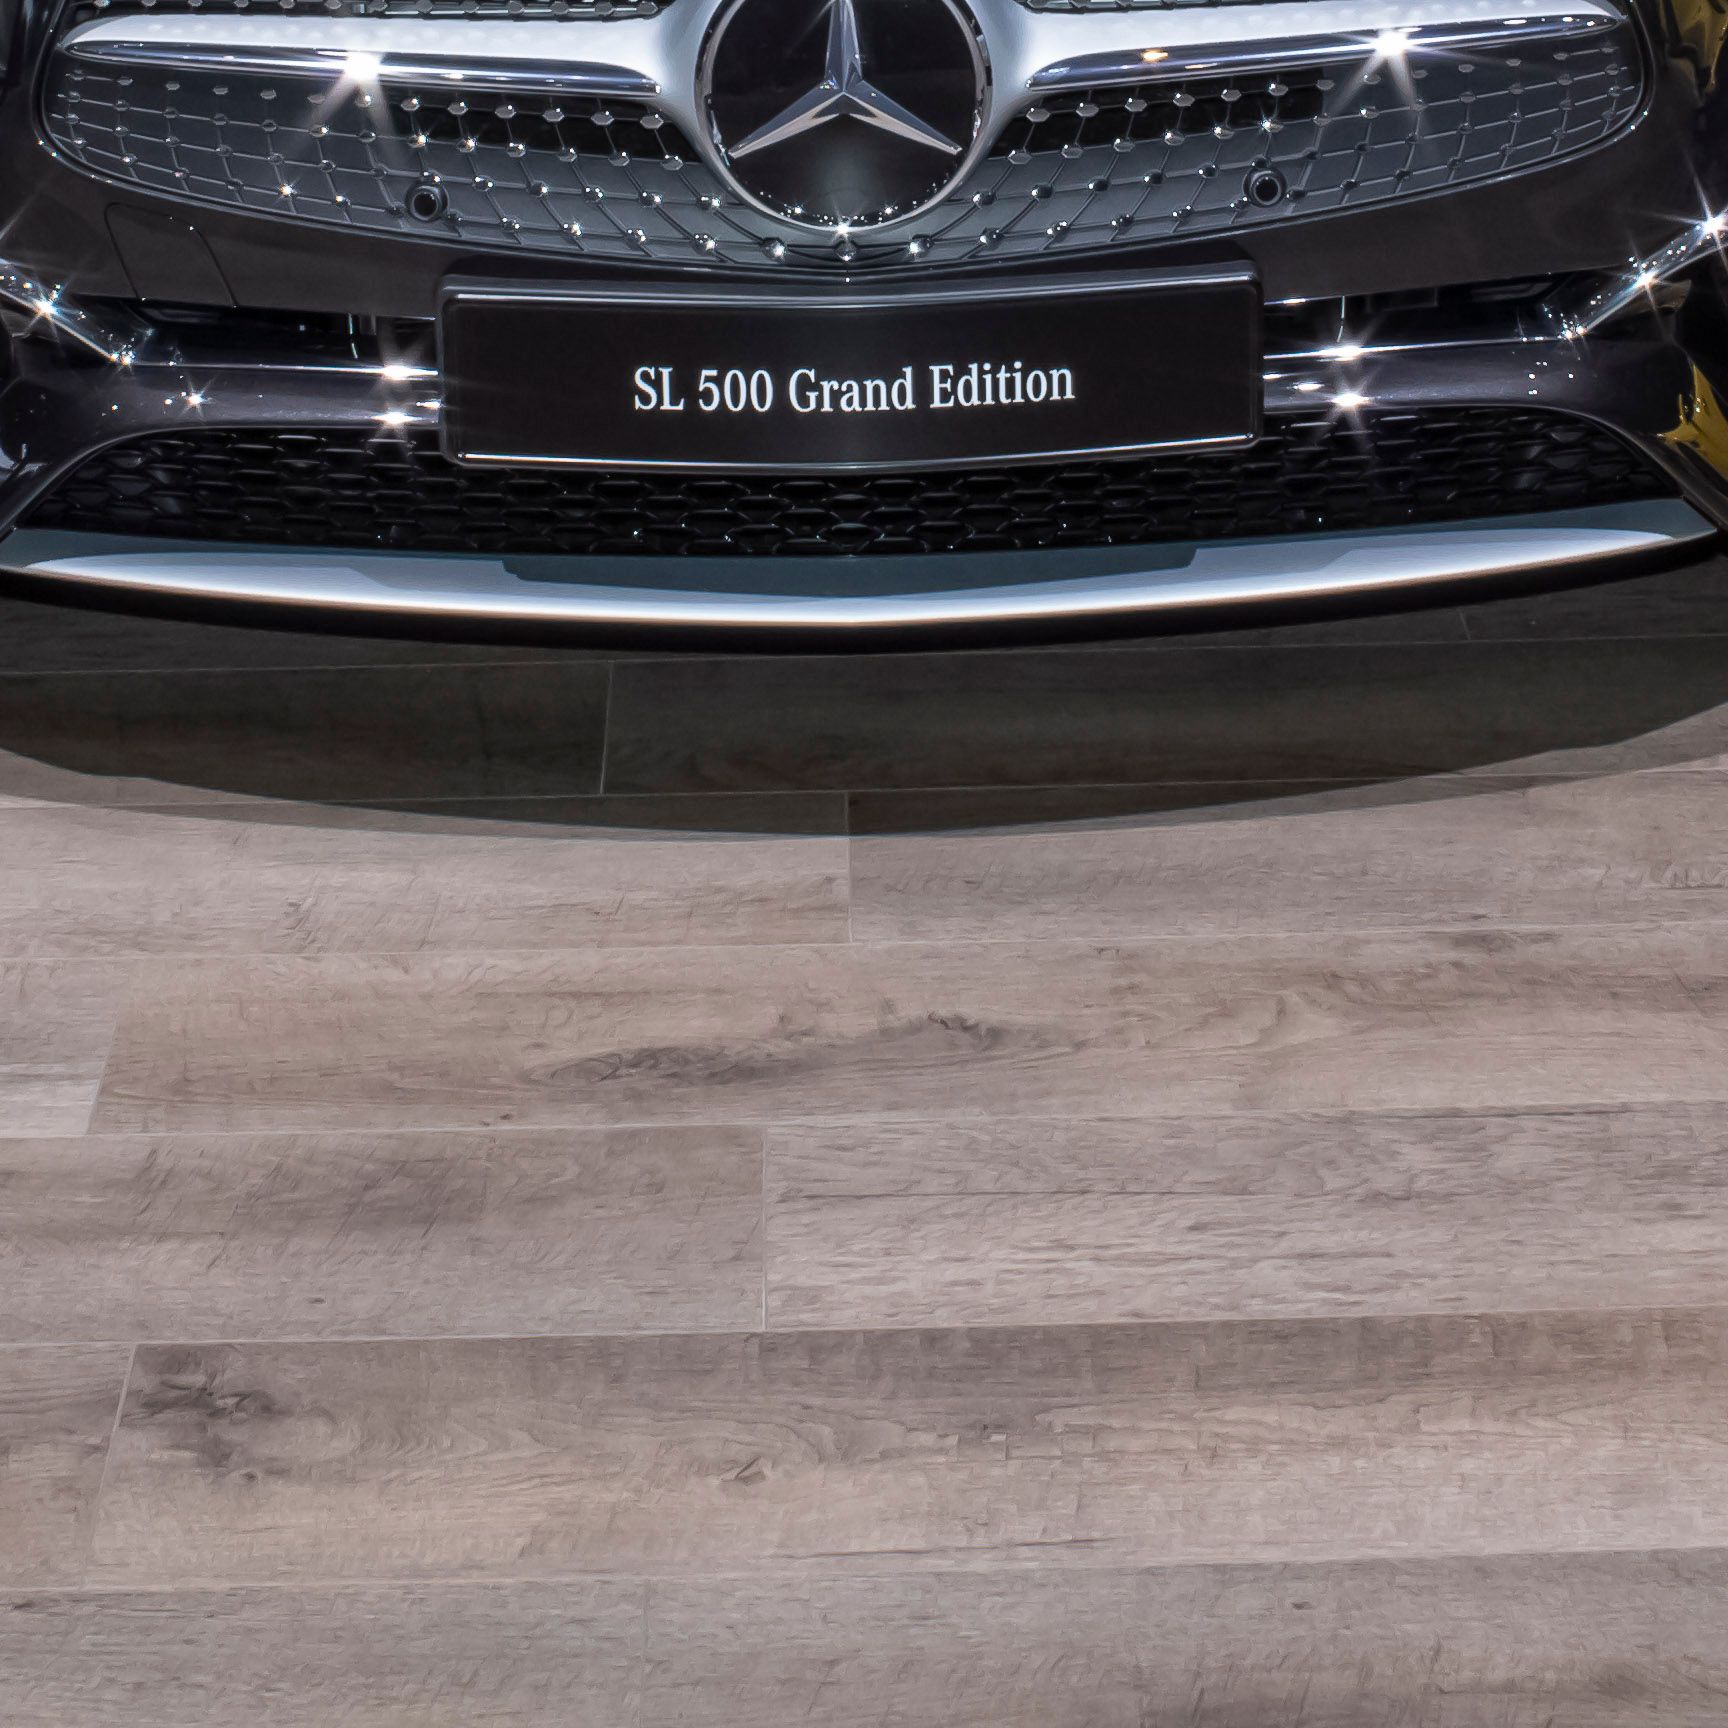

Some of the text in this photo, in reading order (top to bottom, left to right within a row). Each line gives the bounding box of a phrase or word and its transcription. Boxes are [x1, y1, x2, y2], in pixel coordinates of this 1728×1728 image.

[633, 360, 1076, 414] SL 500 Grand Edition
